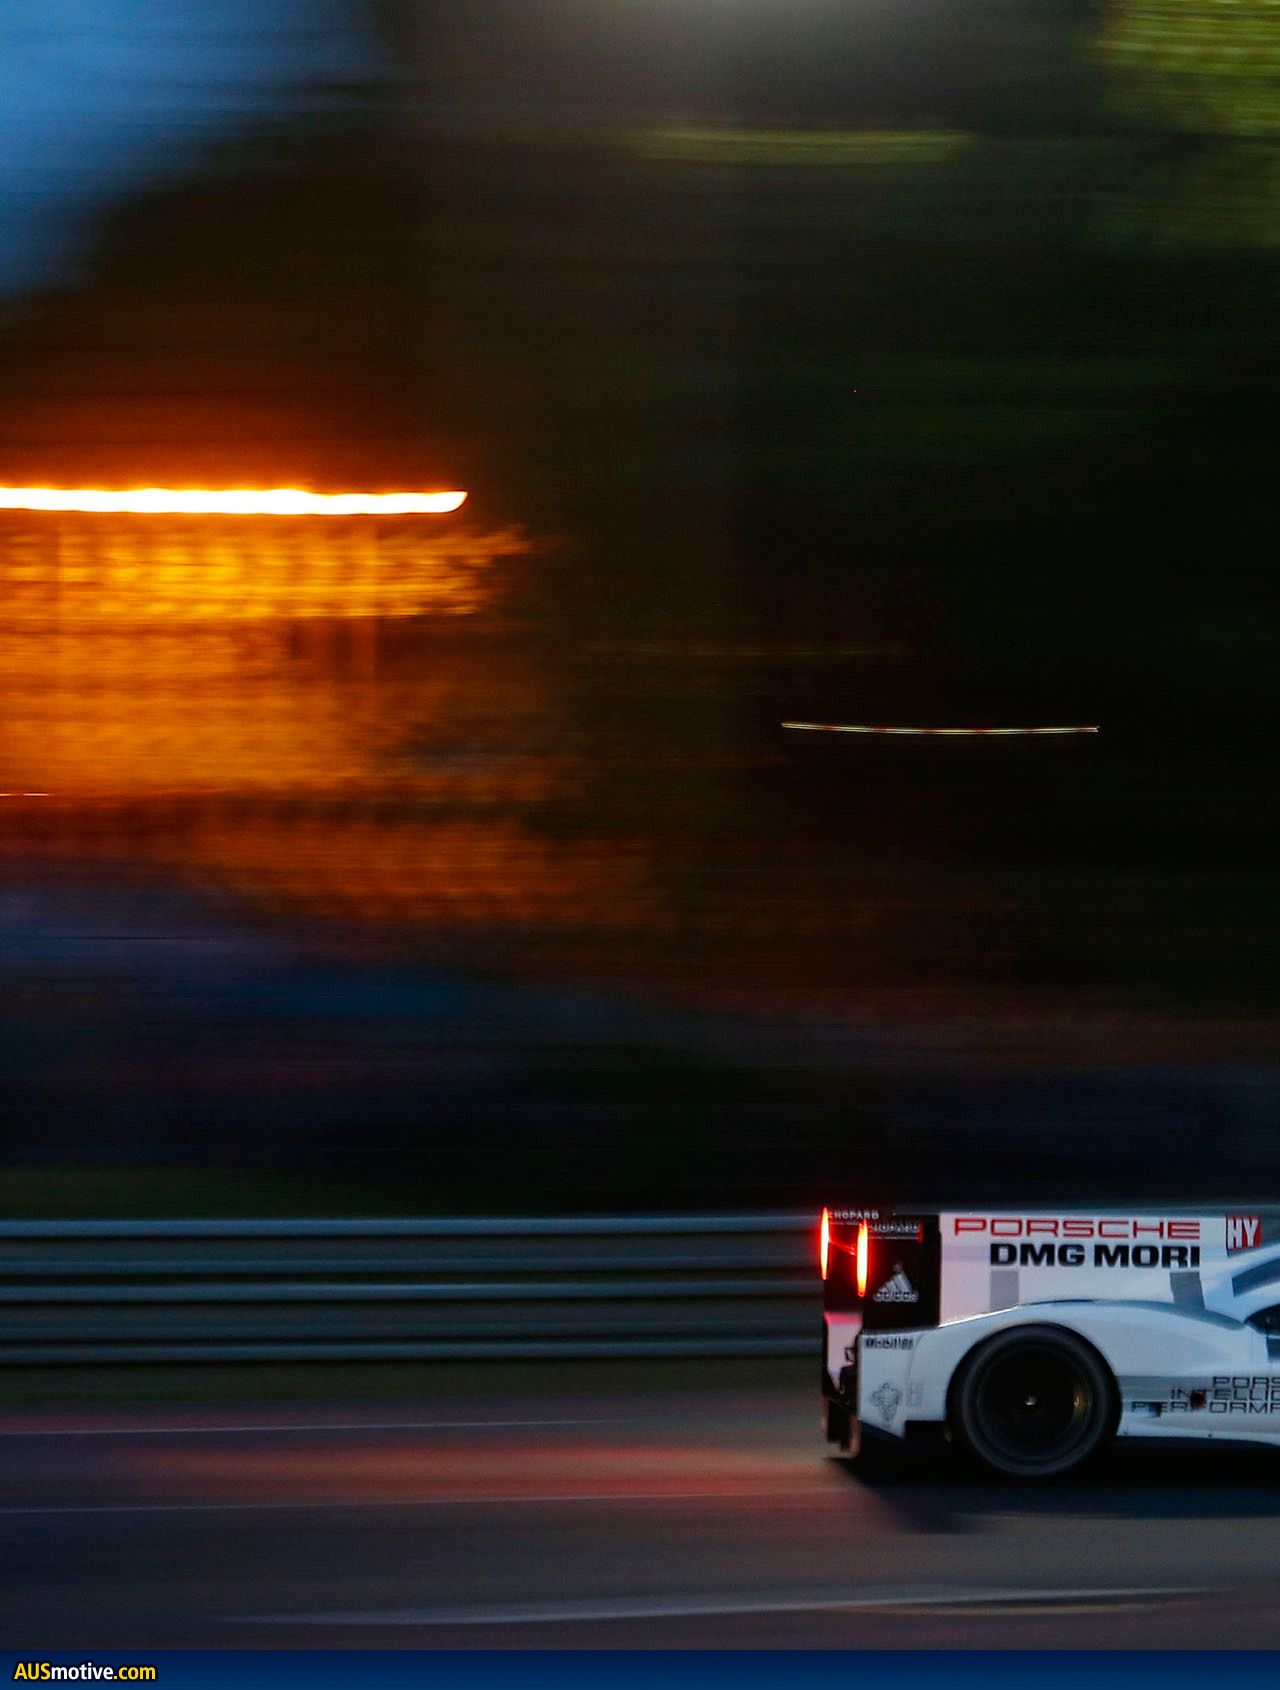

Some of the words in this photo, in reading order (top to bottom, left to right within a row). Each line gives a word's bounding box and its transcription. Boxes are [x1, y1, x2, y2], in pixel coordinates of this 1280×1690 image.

[954, 1218, 1200, 1239] PORSCHE
[1227, 1218, 1259, 1249] HY
[990, 1243, 1086, 1267] DMG
[1094, 1244, 1200, 1268] MORI
